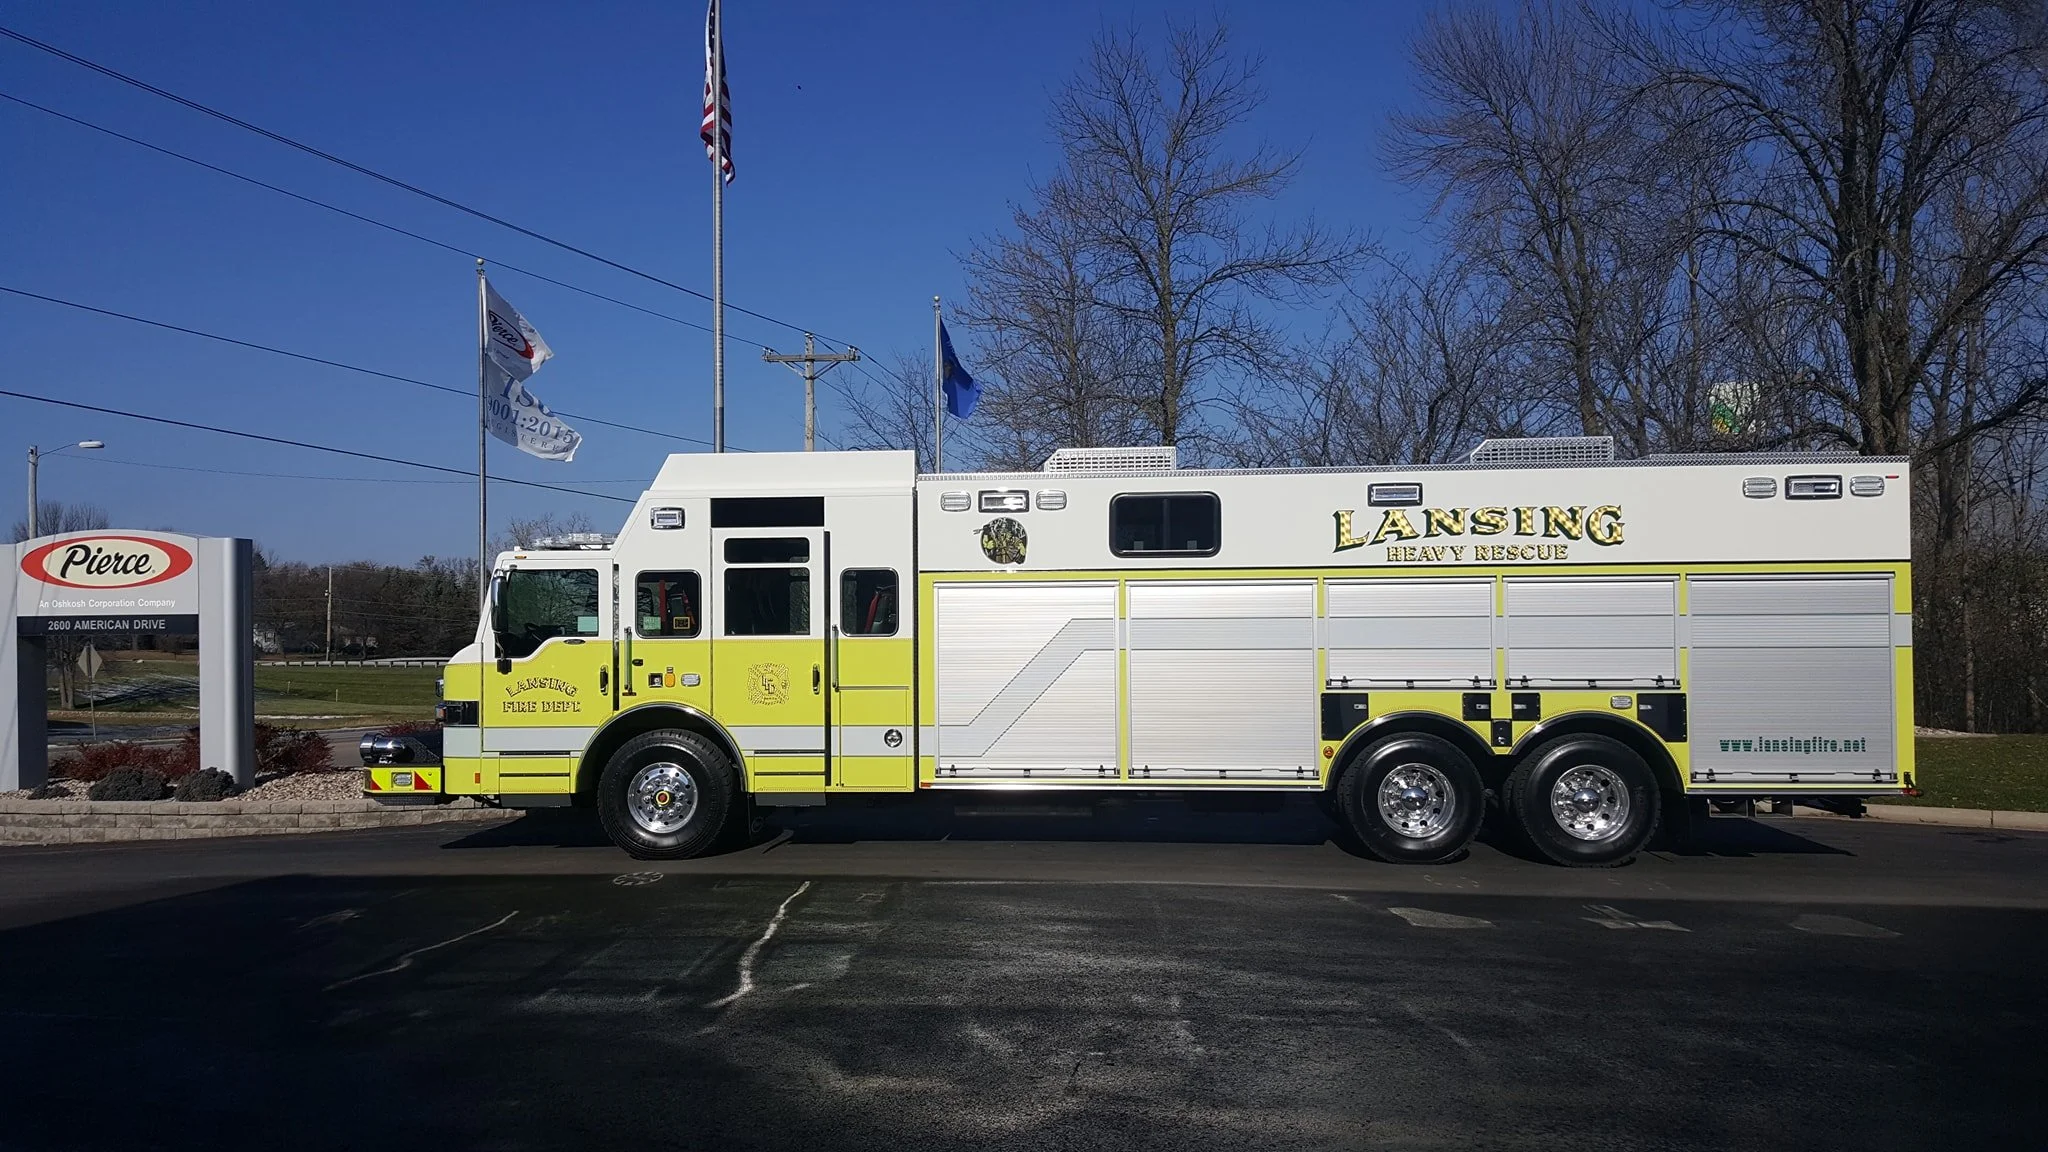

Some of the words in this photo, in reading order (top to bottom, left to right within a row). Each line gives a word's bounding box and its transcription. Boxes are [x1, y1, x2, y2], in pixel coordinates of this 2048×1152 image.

[488, 395, 575, 443] 9001:2015
[1333, 505, 1625, 553] LANSING
[60, 544, 152, 578] Pierce
[1386, 546, 1467, 562] HEAVY
[1475, 544, 1569, 561] RESCUE
[39, 600, 49, 608] An
[52, 600, 86, 608] Oshkosh
[88, 599, 135, 609] Corporation
[138, 599, 176, 608] Company
[48, 620, 71, 631] 2600
[74, 620, 129, 630] AMERICAN
[133, 619, 166, 629] DRIVE
[505, 677, 578, 698] LANSING
[503, 701, 537, 712] FIRE
[1719, 736, 1867, 754] www.lansingfire.net
